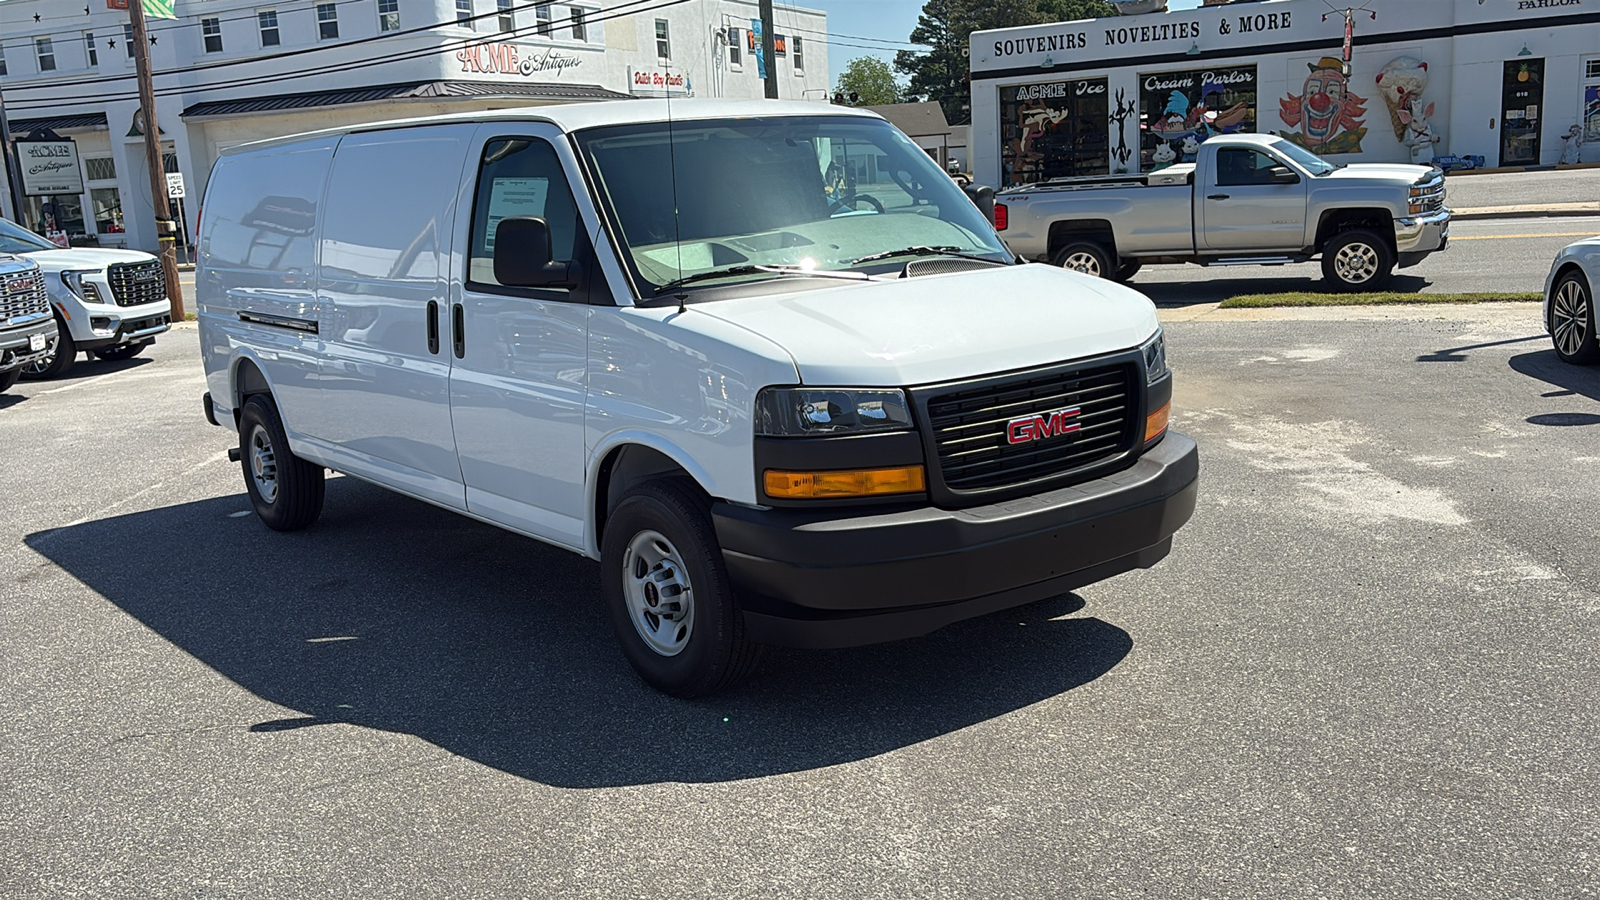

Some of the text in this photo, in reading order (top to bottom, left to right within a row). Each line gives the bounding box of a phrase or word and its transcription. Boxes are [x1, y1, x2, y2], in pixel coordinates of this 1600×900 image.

[994, 11, 1292, 57] SOUVENIRS NOVELTIES & MORE
[456, 40, 521, 75] ACME
[634, 71, 683, 88] Dutch Boy Paints
[1144, 71, 1253, 91] Cream Parlor
[1016, 81, 1105, 100] ACME Ice
[28, 145, 71, 158] ACME
[170, 185, 183, 195] 25
[1007, 407, 1081, 445] GMC
